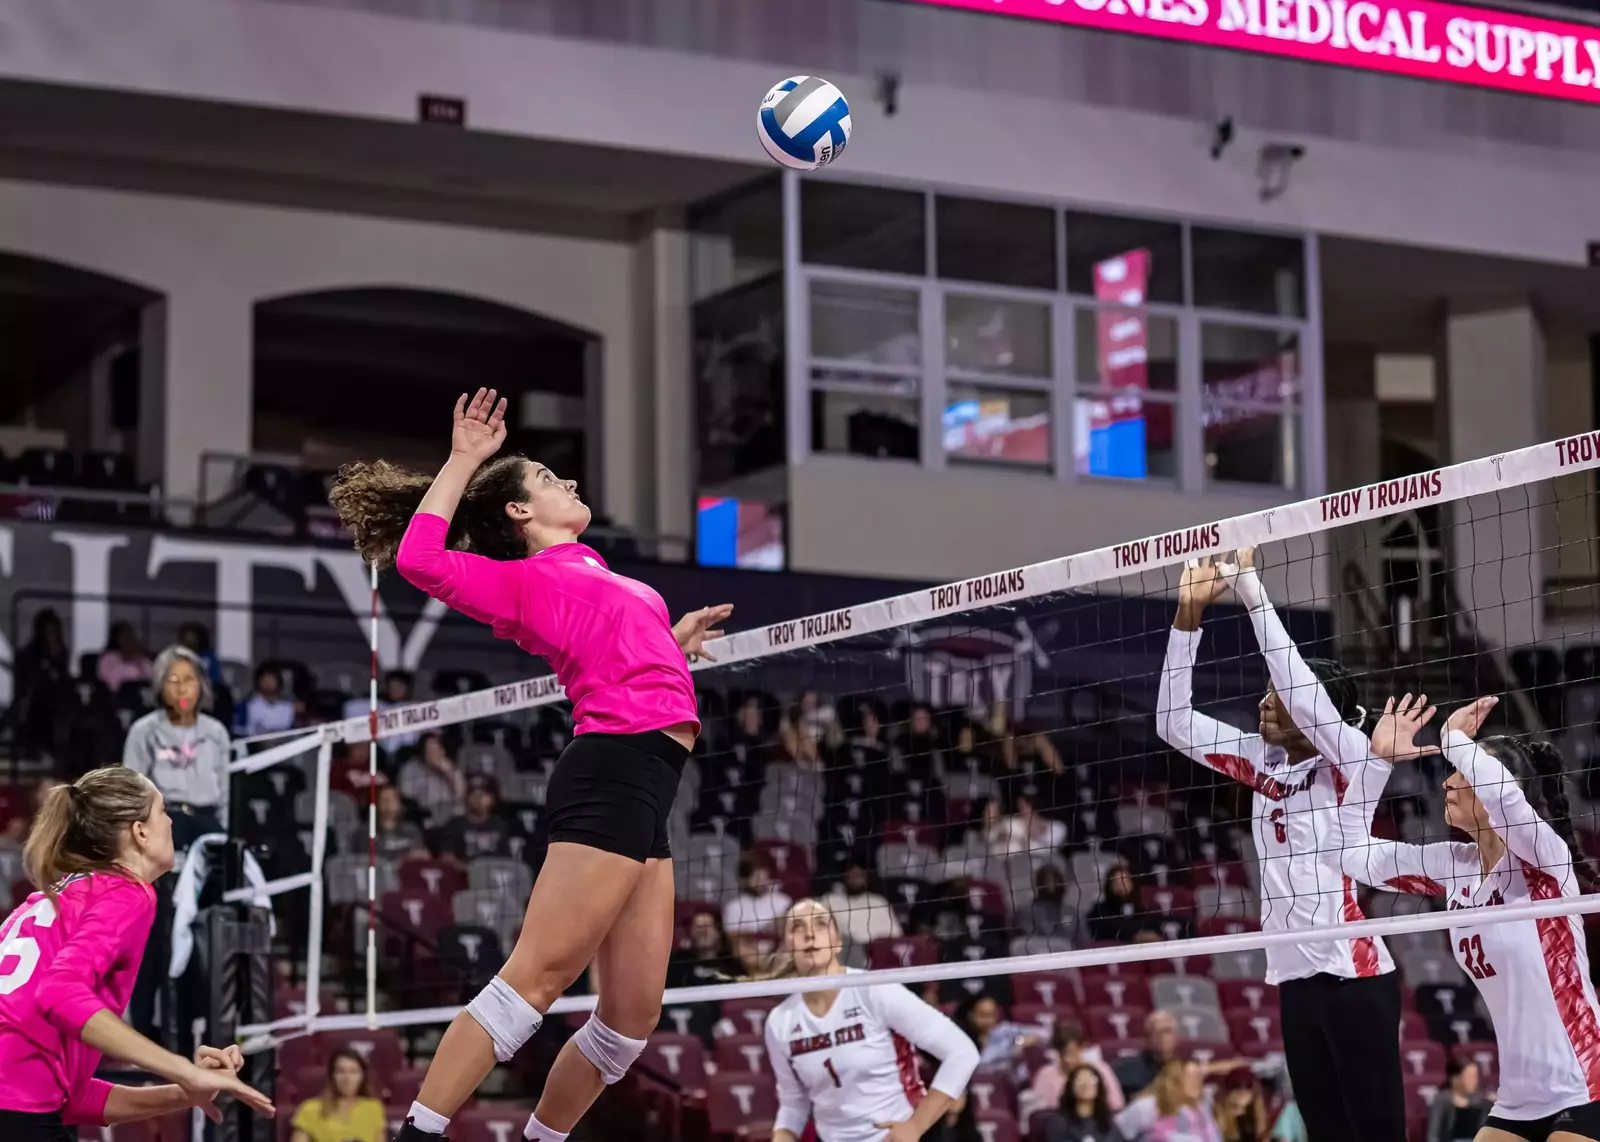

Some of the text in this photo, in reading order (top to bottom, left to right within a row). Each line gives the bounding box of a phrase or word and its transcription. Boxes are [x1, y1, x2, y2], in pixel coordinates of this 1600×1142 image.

[1216, 0, 1441, 63] MEDICAL
[1320, 470, 1442, 522] TROY TROJANS
[1113, 523, 1221, 569] TROY TROJANS
[930, 568, 1025, 611] TROY TROJANS
[767, 609, 852, 647] TROY TROJANS
[494, 677, 562, 708] TROY TROJANS
[1269, 808, 1286, 844] 6
[1459, 934, 1497, 979] 22
[823, 1057, 842, 1088] 1
